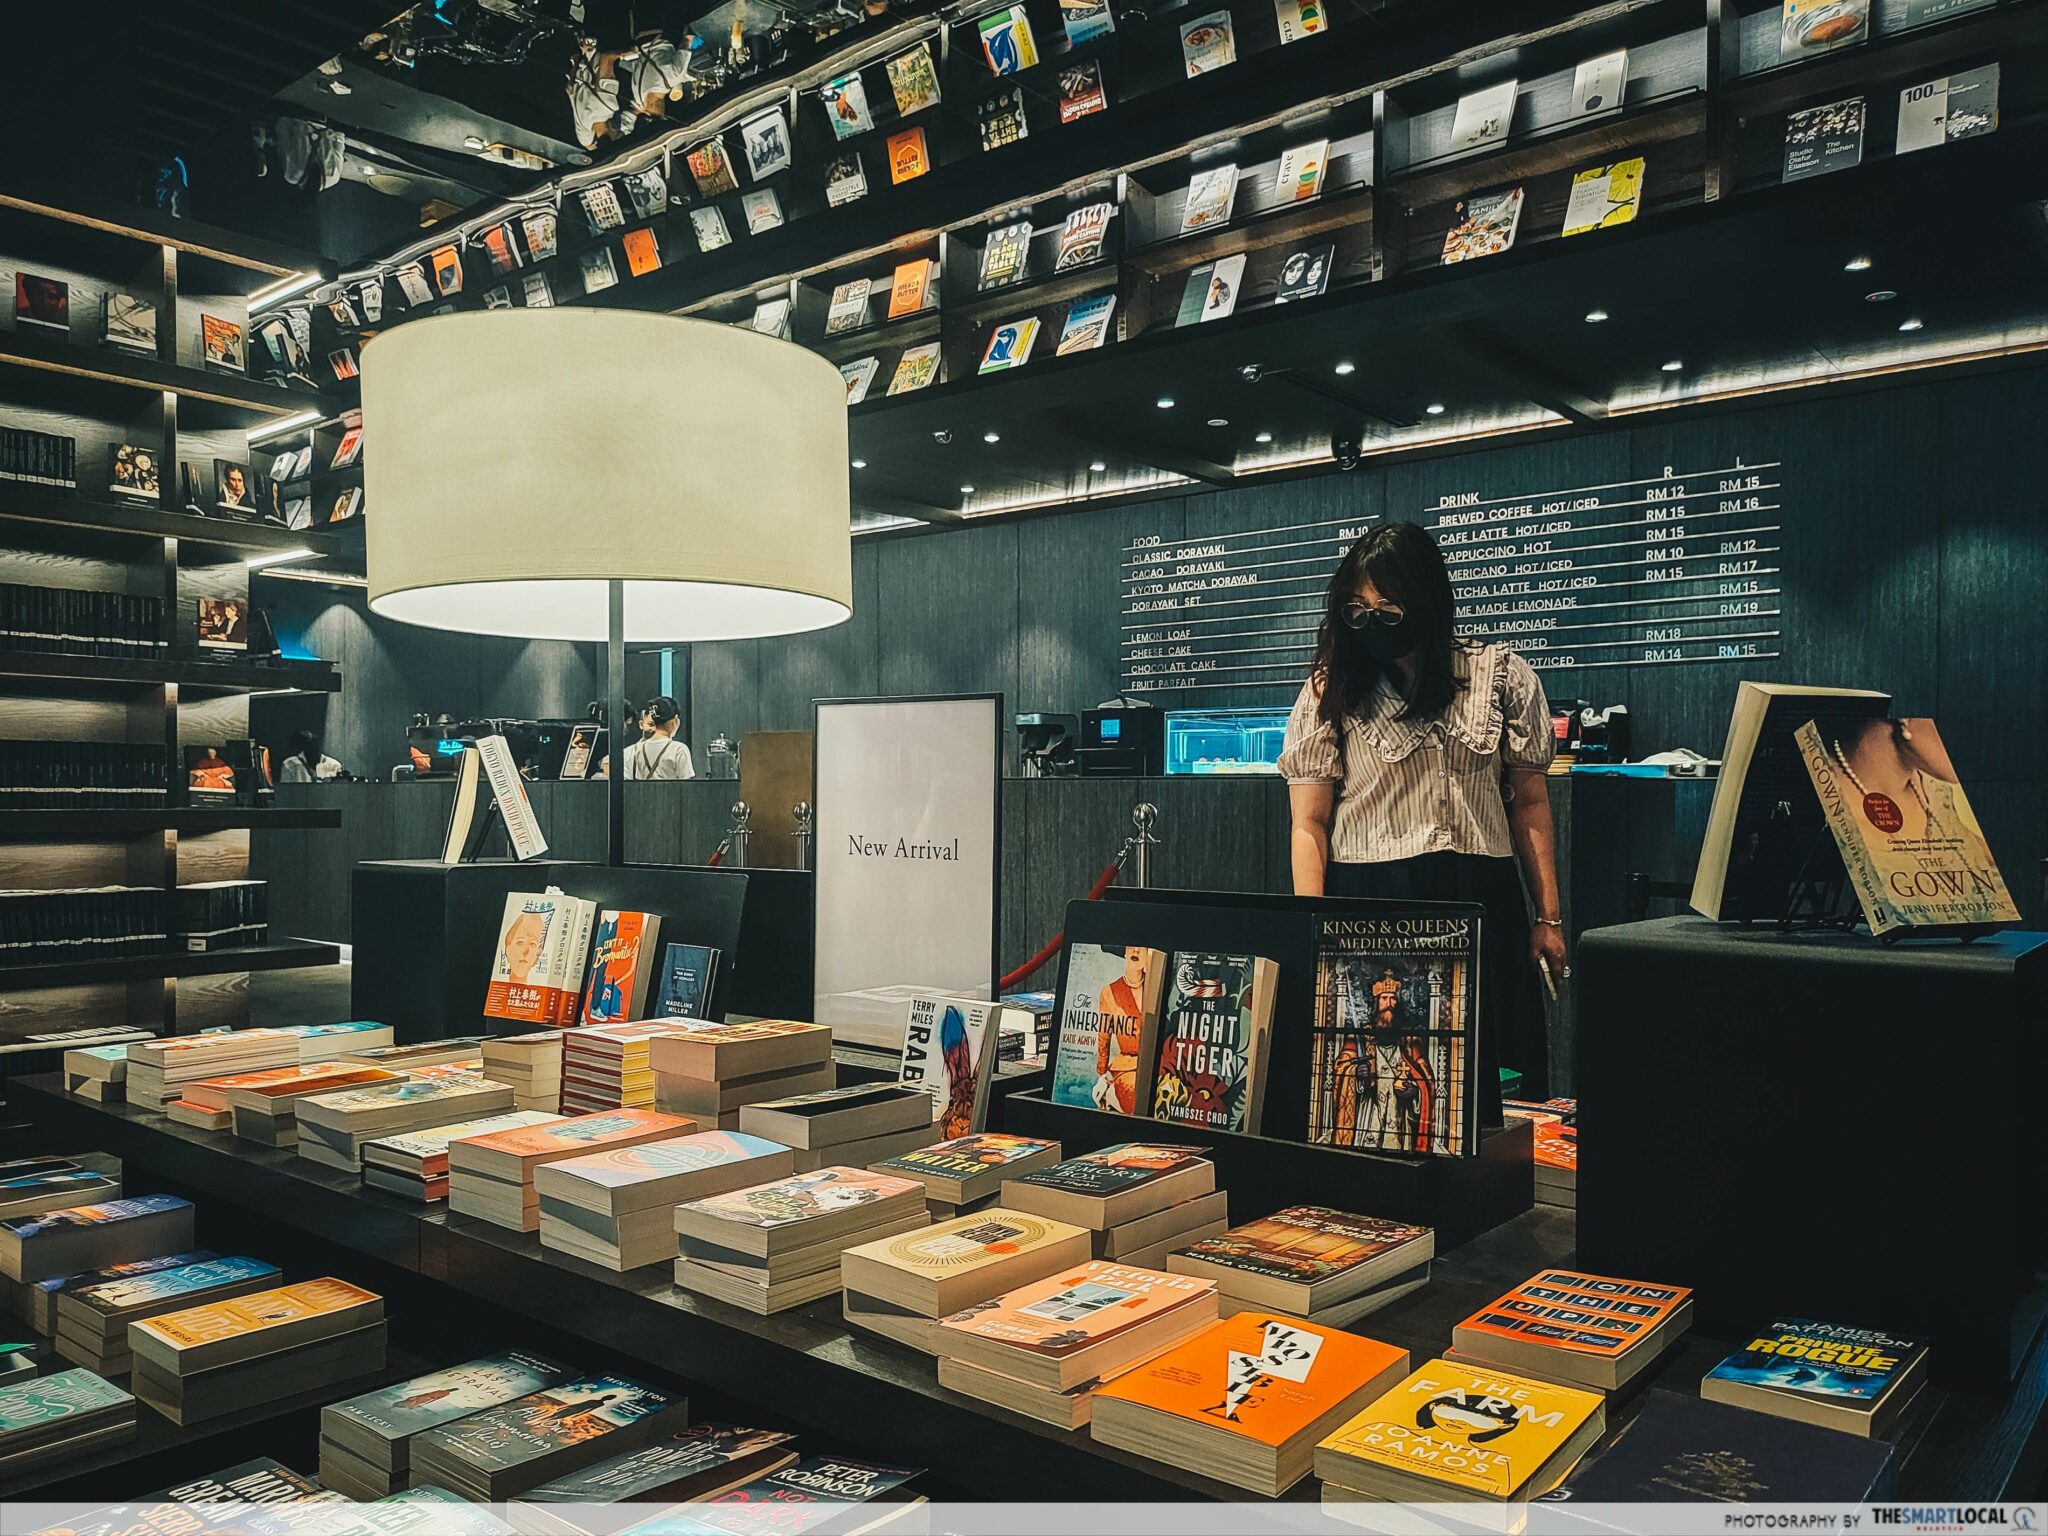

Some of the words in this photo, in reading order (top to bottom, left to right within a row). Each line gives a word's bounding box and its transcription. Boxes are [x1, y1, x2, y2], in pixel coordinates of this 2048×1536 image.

[1904, 83, 1934, 104] 100
[1788, 148, 1814, 158] Studio
[1664, 466, 1673, 479] R
[1736, 456, 1745, 469] L
[1439, 492, 1480, 508] DRINK
[1439, 511, 1485, 527] BREWED
[1489, 504, 1533, 519] COFFEE
[1542, 497, 1599, 514] HOT/ICED
[1646, 487, 1669, 502] RM
[1671, 485, 1685, 498] 12
[1719, 478, 1741, 492] RM
[1744, 476, 1760, 489] 15
[1439, 532, 1467, 546] CAFE
[1472, 527, 1508, 541] LATTE
[1515, 521, 1572, 537] HOT/ICED
[1646, 508, 1669, 522] RM
[1671, 505, 1685, 518] 15
[1719, 498, 1741, 513] RM
[1744, 496, 1759, 510] 16
[1132, 551, 1171, 565] CLASSIC
[1177, 545, 1225, 560] DORAYAKI
[1339, 527, 1355, 540] RM
[1356, 525, 1369, 538] 10
[1133, 536, 1161, 548] FOOD
[1442, 545, 1516, 563] CAPPUCCINO
[1524, 541, 1552, 554] HOT
[1646, 528, 1669, 542] RM
[1671, 526, 1685, 539] 15
[1447, 565, 1507, 580] MERICANO
[1515, 559, 1573, 575] HOT/ICED
[1646, 549, 1668, 562] RM
[1670, 546, 1684, 560] 10
[1720, 541, 1741, 554] RM
[1743, 539, 1757, 552] 12
[1132, 568, 1164, 580] CACAO
[1176, 561, 1225, 576] DORAYAKI
[1493, 581, 1530, 596] LATTE
[1538, 576, 1597, 592] HOT/ICED
[1646, 568, 1668, 582] RM
[1670, 566, 1683, 579] 15
[1719, 561, 1741, 575] RM
[1742, 559, 1758, 573] 17
[1131, 584, 1163, 596] KYOTO
[1168, 579, 1206, 593] MATCHA
[1212, 574, 1258, 588] DORAYAKI
[1132, 599, 1178, 612] DORAYAKI
[1184, 596, 1202, 608] SET
[1475, 602, 1509, 616] MADE
[1512, 596, 1578, 613] LEMONADE
[1719, 583, 1741, 596] RM
[1743, 581, 1758, 594] 15
[1493, 617, 1557, 633] LEMONADE
[1720, 603, 1741, 616] RM
[1743, 601, 1758, 615] 19
[1131, 632, 1163, 643] LEMON
[1168, 629, 1191, 641] LOAF
[1646, 630, 1667, 642] RM
[1669, 628, 1682, 640] 18
[1131, 647, 1163, 659] CHEESE
[1168, 645, 1192, 656] CAKE
[1645, 650, 1666, 662] RM
[1669, 648, 1682, 660] 14
[1718, 645, 1740, 658] RM
[1742, 643, 1757, 656] 15
[1131, 662, 1186, 674] CHOCOLATE
[1191, 660, 1217, 671] CAKE
[1131, 679, 1155, 690] FRUIT
[1159, 677, 1196, 689] PARFAIT
[482, 743, 501, 769] TOKYO
[492, 769, 512, 797] REDUX
[502, 797, 520, 822] DAVID
[511, 821, 530, 848] PEACE
[1811, 755, 1845, 817] GOWN
[1837, 817, 1861, 866] JENNIFER
[1858, 865, 1880, 906] ROBSON
[1874, 819, 1900, 827] CROWN
[848, 834, 888, 857] New
[894, 836, 959, 861] Arrival
[1922, 857, 1946, 868] THE
[1890, 870, 1998, 898] GOWN
[1902, 903, 1959, 916] JENNIFER
[1960, 902, 2006, 913] ROBSON
[1322, 920, 1376, 935] KINGS
[1380, 920, 1392, 935] &
[1396, 918, 1469, 937] QUEENS
[593, 936, 640, 968] Bromantic?
[1339, 937, 1410, 949] MEDIEVAL
[1413, 936, 1470, 949] WORLD
[665, 999, 694, 1009] MADELINE
[668, 1006, 689, 1015] MILLER
[911, 1000, 936, 1013] TERRY
[1072, 993, 1092, 1009] The
[1202, 1000, 1216, 1012] THE
[911, 1012, 934, 1025] MILES
[1064, 1008, 1138, 1038] INHERITANCE
[1177, 1011, 1238, 1045] NIGHT
[1063, 1033, 1077, 1045] KATIE
[1077, 1035, 1097, 1047] AGNEW
[1176, 1042, 1234, 1078] TIGER
[1170, 1105, 1204, 1122] YANGSZE
[1206, 1111, 1228, 1125] CHOO
[899, 1151, 990, 1174] WAITER
[904, 1164, 963, 1180] CHOWDHURY
[1043, 1163, 1143, 1179] MEMORY
[1055, 1169, 1101, 1181] BOX
[1323, 1221, 1360, 1232] HOUSE
[1185, 1251, 1233, 1267] MARGA
[1237, 1263, 1300, 1280] ORTIGAS
[1087, 1262, 1196, 1291] Victoria
[1090, 1273, 1152, 1293] Park
[1536, 1289, 1642, 1315] THE
[983, 1319, 1043, 1337] Gemma
[1771, 1322, 1914, 1348] PATTERSON
[1802, 1322, 1888, 1339] JAMES
[1745, 1338, 1900, 1371] ROGUE
[1777, 1334, 1884, 1357] PRIVATE
[473, 1368, 514, 1386] LAST
[493, 1363, 527, 1378] HER
[439, 1369, 511, 1400] BETRAYAL
[602, 1375, 631, 1390] TRENT
[630, 1386, 667, 1402] DALTON
[1468, 1378, 1532, 1401] THE
[1406, 1378, 1568, 1429] FARM
[343, 1405, 367, 1418] PAM
[366, 1412, 395, 1430] LECKY
[460, 1426, 511, 1449] Skies
[469, 1410, 552, 1454] Shimmering
[1362, 1433, 1491, 1475] RAMOS
[1363, 1422, 1512, 1467] JOANNE
[627, 1446, 716, 1467] POWER
[772, 1468, 886, 1498] ROBINSON
[814, 1463, 879, 1484] PETER
[768, 1489, 818, 1505] NOT
[707, 1490, 830, 1531] DARK
